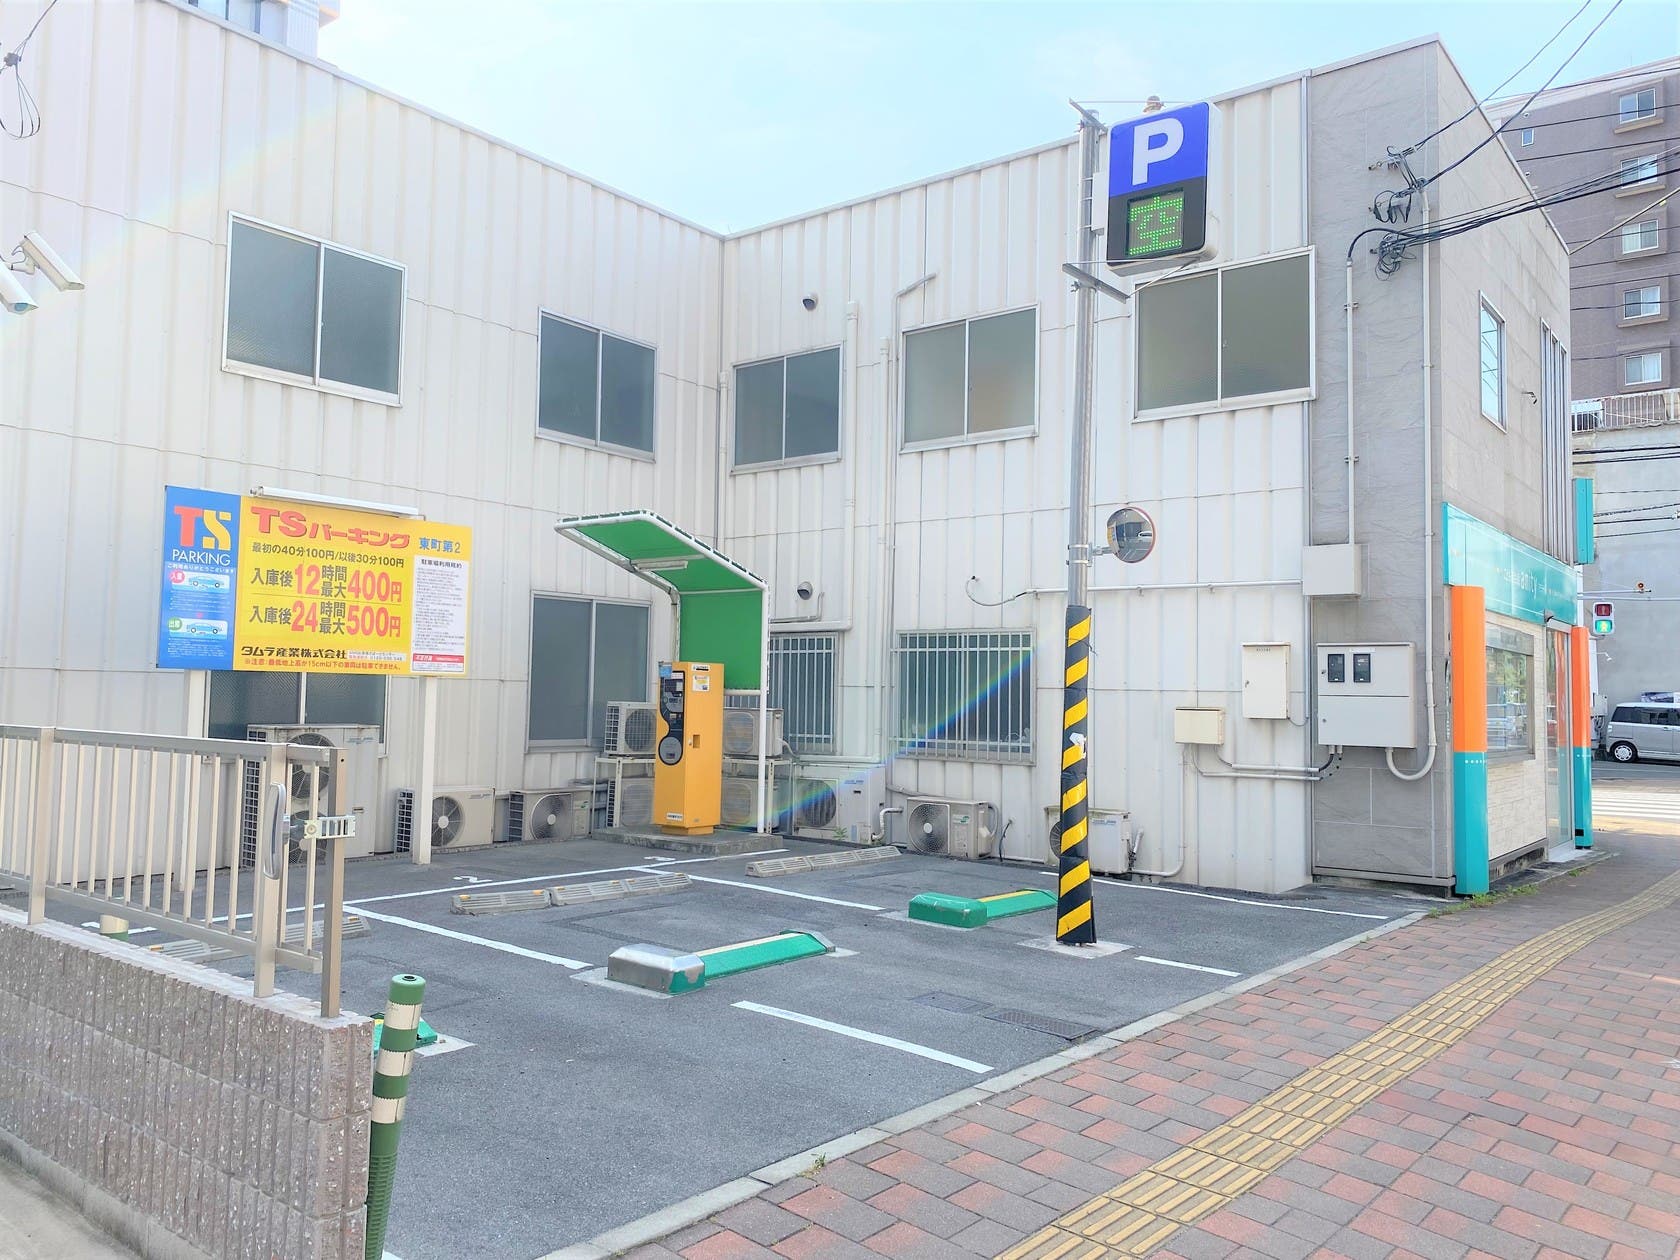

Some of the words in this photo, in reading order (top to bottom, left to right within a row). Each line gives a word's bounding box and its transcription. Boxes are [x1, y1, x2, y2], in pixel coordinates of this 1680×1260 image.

[1132, 117, 1185, 186] P
[1128, 196, 1183, 255] 空
[174, 505, 231, 551] TS
[250, 506, 411, 549] TSパーキング
[418, 537, 461, 553] 東町第2
[172, 548, 231, 566] PARKING
[241, 646, 348, 660] タムラ産業株式会社
